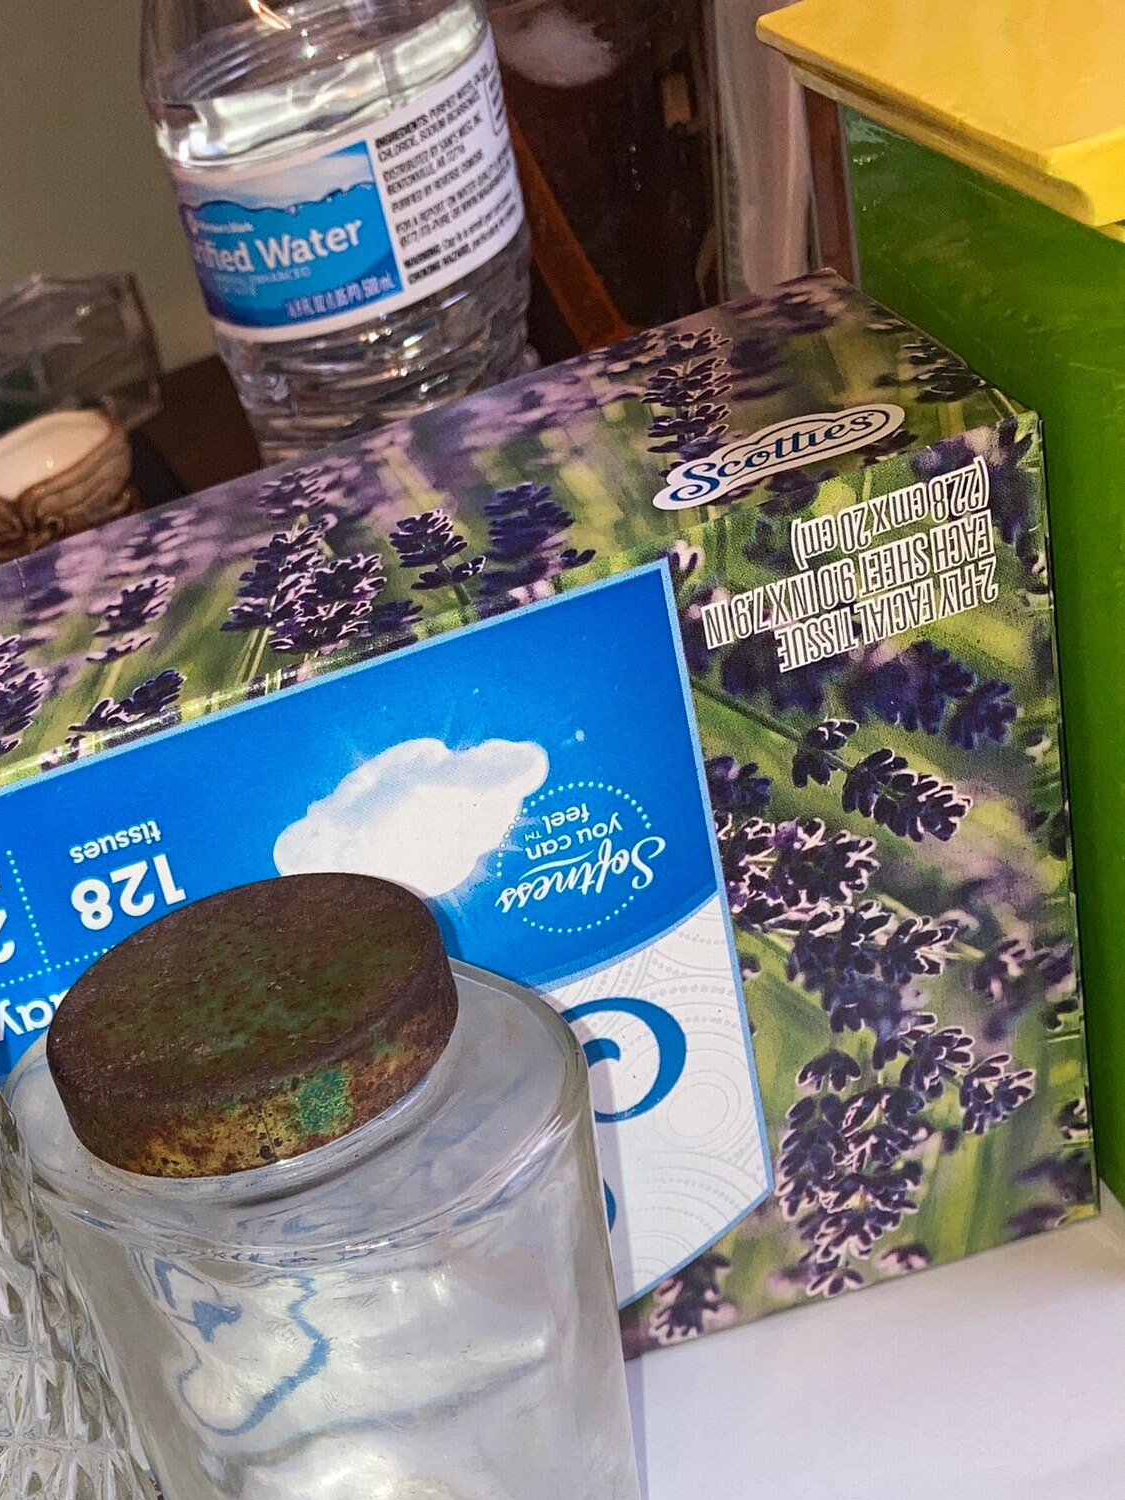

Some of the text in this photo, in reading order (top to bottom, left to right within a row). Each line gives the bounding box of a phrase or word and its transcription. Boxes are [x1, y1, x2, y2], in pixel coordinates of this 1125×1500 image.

[254, 219, 363, 270] Water
[670, 416, 872, 501] Scotties
[838, 505, 873, 553] 20
[887, 482, 929, 529] cm
[858, 532, 929, 598] SHEET
[930, 509, 995, 574] EACH
[701, 600, 734, 651] IN
[776, 555, 999, 673] 2-PLY FACIAL TISSUE
[69, 820, 162, 864] tissues
[525, 812, 624, 860] you can
[541, 802, 590, 834] feel
[70, 854, 187, 931] 128
[495, 836, 667, 913] Softness
